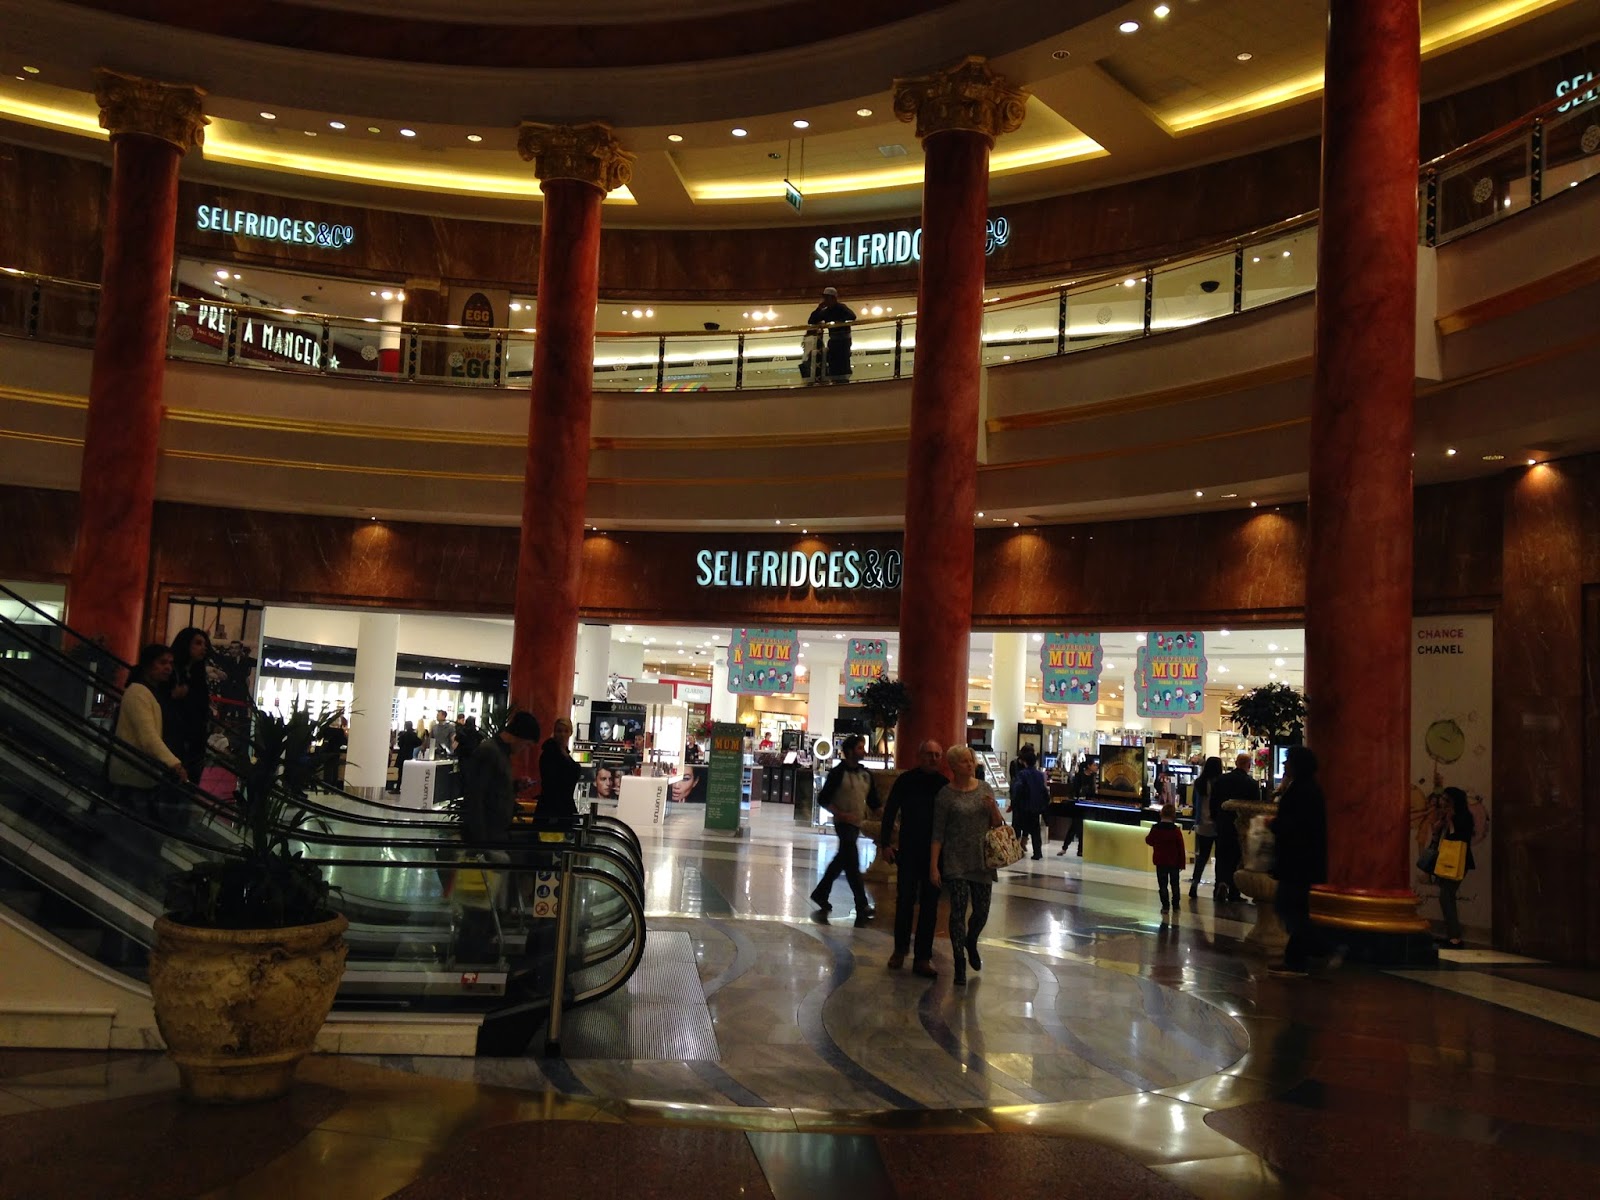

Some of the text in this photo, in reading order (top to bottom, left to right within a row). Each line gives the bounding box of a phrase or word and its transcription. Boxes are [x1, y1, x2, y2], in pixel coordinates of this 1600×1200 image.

[1556, 72, 1600, 112] SEL
[466, 309, 490, 321] EGG
[197, 299, 236, 334] PRE
[243, 318, 253, 343] A
[262, 322, 321, 369] MANGER
[696, 549, 901, 589] SELFRIDGES&C
[1417, 629, 1464, 639] CHANCE
[748, 643, 791, 661] MUM
[1417, 645, 1464, 654] CHANEL
[264, 657, 312, 671] MAC
[1048, 651, 1094, 669] MUM
[424, 671, 461, 683] MAC
[850, 664, 883, 678] MUM
[1152, 662, 1199, 679] MUM
[714, 737, 741, 752] MUM
